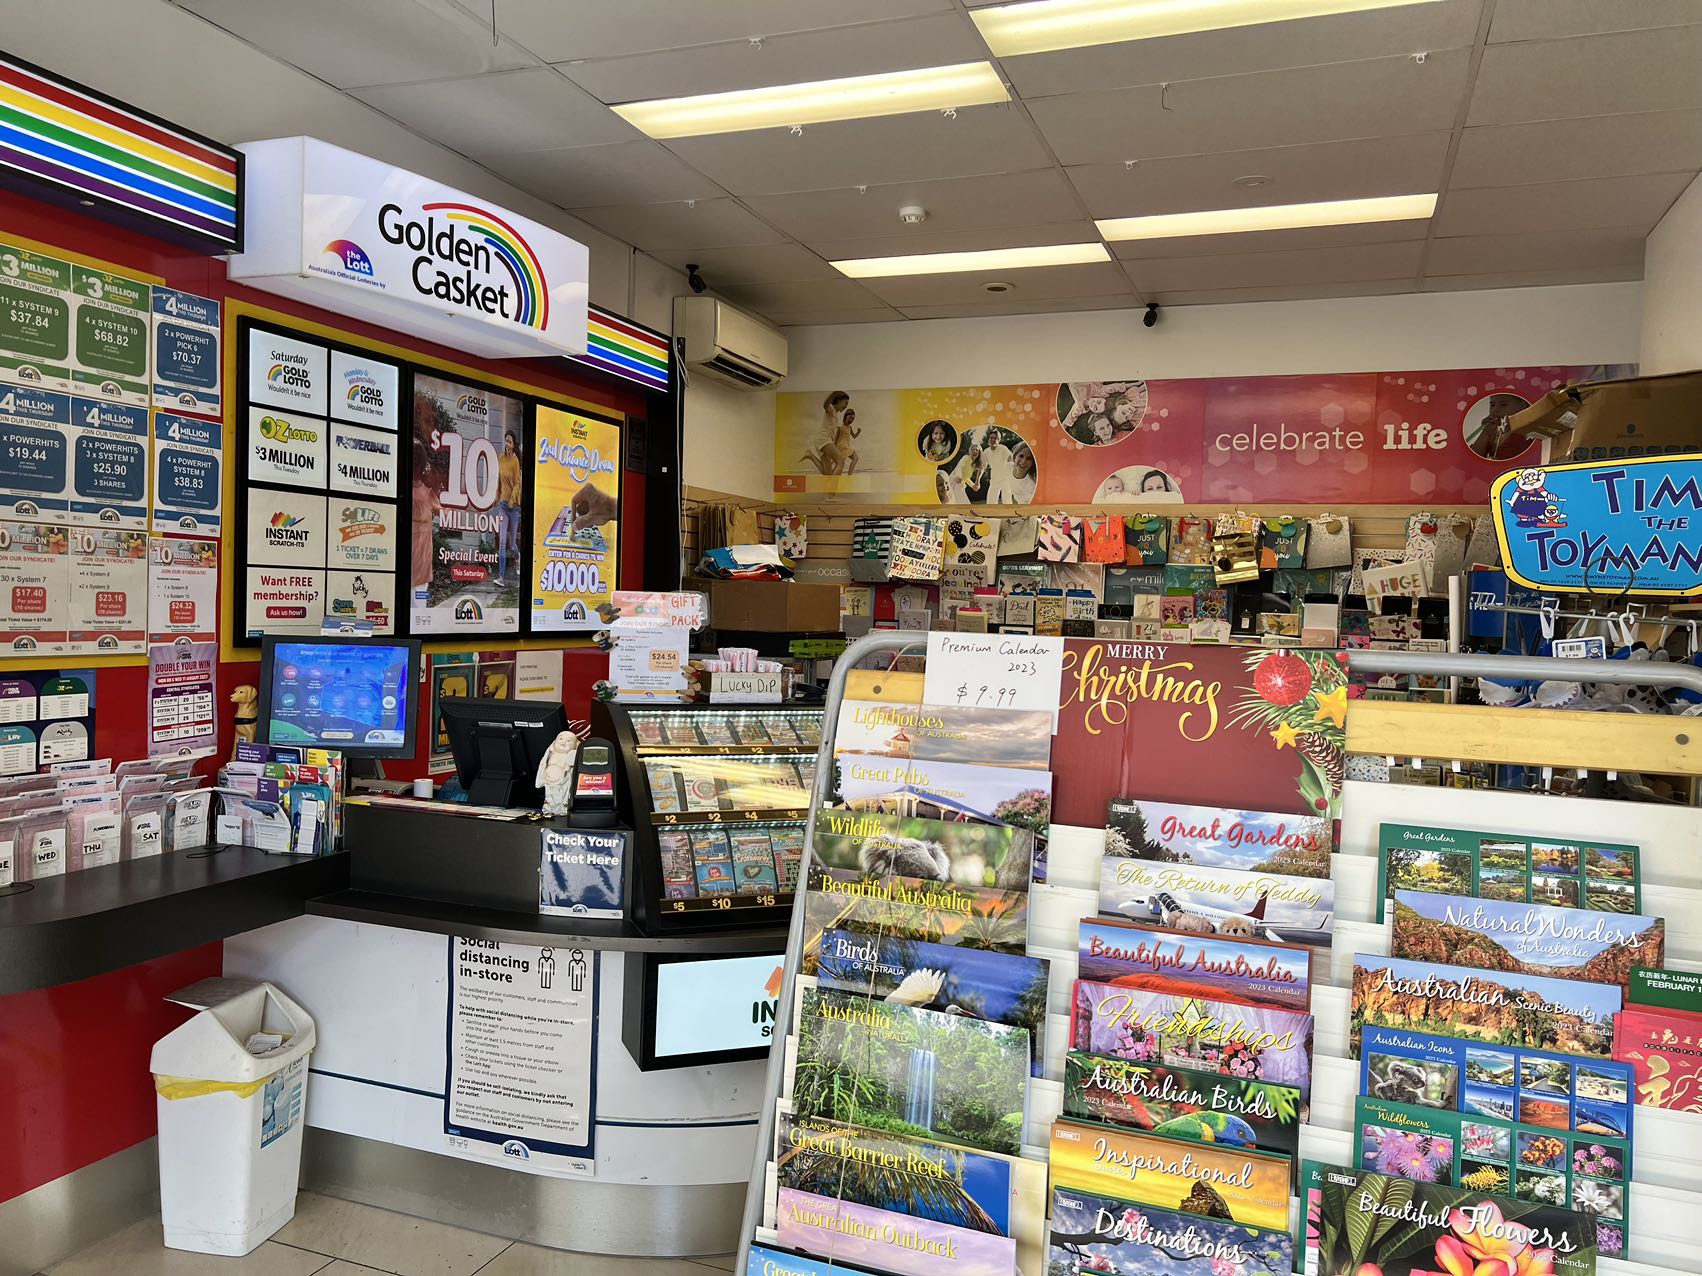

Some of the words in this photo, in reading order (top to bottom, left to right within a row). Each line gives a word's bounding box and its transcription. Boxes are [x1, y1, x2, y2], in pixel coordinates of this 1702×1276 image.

[378, 204, 491, 274] Golden
[346, 249, 361, 261] the
[346, 259, 370, 273] Lott
[308, 264, 336, 276] Australia's
[337, 271, 356, 282] Official
[357, 276, 379, 288] Lotteries
[412, 256, 509, 319] Casket
[10, 309, 49, 328] $37.84
[94, 329, 129, 347] $68.82
[172, 351, 201, 365] $70.37
[271, 350, 308, 366] Saturday
[283, 365, 308, 378] GOLD
[283, 376, 311, 389] LOTTO
[360, 386, 382, 397] GOLD
[360, 396, 384, 407] LOTTO
[260, 415, 290, 443] OZ
[288, 428, 317, 442] LOTTO
[1215, 423, 1364, 451] celebrate
[1382, 422, 1448, 450] life
[9, 434, 60, 449] POWERHITS
[8, 447, 47, 461] $19.44
[255, 446, 267, 461] $3
[268, 450, 315, 470] MILLION
[539, 438, 558, 464] 2nd
[560, 445, 591, 470] Chance
[93, 463, 127, 476] $25.90
[338, 463, 348, 477] $4
[350, 467, 389, 483] MILLION
[431, 429, 500, 511] $10
[174, 477, 204, 489] $38.83
[1591, 469, 1702, 514] TIM
[1641, 516, 1690, 531] THE
[266, 528, 310, 541] INSTANT
[1138, 534, 1155, 542] JUST
[269, 539, 305, 548] SCRATCH-ITS
[439, 547, 472, 563] Special
[474, 550, 499, 563] Event
[1526, 530, 1702, 575] TOYMAN
[261, 576, 287, 587] Want
[290, 576, 313, 587] FREE
[453, 569, 463, 577] This
[463, 570, 484, 579] Saturday
[540, 561, 599, 594] $10,000
[1380, 574, 1422, 593] HUGE
[253, 591, 319, 603] membership?
[671, 595, 696, 608] GIFT
[288, 608, 303, 616] how!
[455, 605, 474, 620] Lott
[564, 607, 579, 620] Lott
[671, 615, 699, 626] PACK
[941, 638, 992, 654] Premium
[999, 641, 1050, 656] Calendar
[1107, 643, 1168, 660] MERRY
[652, 653, 676, 661] $24.54
[156, 662, 180, 673] DOUBLE
[181, 661, 197, 671] YOUR
[198, 660, 211, 669] WIN
[1008, 662, 1037, 676] 2023
[976, 685, 1017, 708] 9.99
[854, 707, 944, 730] Lighthouses
[927, 731, 967, 740] AUSTRALIA
[851, 764, 891, 783] Great
[894, 770, 929, 786] Pubs
[665, 815, 677, 824] $2
[708, 813, 721, 822] $2
[745, 811, 758, 820] $4
[787, 811, 798, 819] $5
[829, 816, 887, 838] Wildlife
[1160, 815, 1222, 843] Great
[1227, 821, 1322, 852] Gardens
[143, 832, 159, 841] SAT
[546, 833, 585, 847] Check
[587, 836, 619, 848] Your
[1403, 831, 1424, 842] Great
[1425, 833, 1456, 844] Gardens
[83, 844, 102, 854] THU
[863, 840, 902, 850] AUSTRALIA
[38, 852, 57, 862] WED
[545, 851, 584, 864] Ticket
[587, 853, 619, 865] Here
[1273, 855, 1290, 865] 2023
[1292, 857, 1325, 868] Calendar
[1116, 861, 1154, 886] The
[1154, 869, 1232, 896] Return
[1234, 881, 1258, 899] of
[1254, 877, 1322, 909] Teddy
[756, 895, 775, 906] $15
[821, 875, 893, 902] Beautiful
[896, 885, 972, 912] Australia
[673, 901, 685, 911] $5
[712, 898, 731, 909] $10
[1438, 905, 1537, 937] Natural
[1538, 912, 1647, 948] Wonders
[460, 937, 500, 950] Social
[835, 938, 879, 962] Birds
[1517, 940, 1527, 954] of
[1527, 941, 1592, 959] Australia
[460, 950, 530, 973] distancing
[1089, 935, 1186, 971] Beautiful
[1189, 949, 1298, 985] Australia
[460, 965, 513, 983] in-store
[864, 963, 904, 976] AUSTRALIA
[1647, 980, 1696, 992] FEBRUARY
[1673, 975, 1699, 984] LUNAR
[1248, 982, 1266, 992] 2023
[1268, 985, 1300, 996] Calendar
[1371, 968, 1513, 1007] Australian
[1515, 996, 1552, 1014] Scenic
[1553, 1001, 1596, 1024] Beauty
[816, 1000, 891, 1030] Australia
[1097, 994, 1297, 1054] Friendships
[1552, 1021, 1574, 1032] 2023
[1575, 1024, 1614, 1037] Calendar
[1371, 1033, 1426, 1052] Australian
[1427, 1039, 1456, 1056] Icons
[1082, 1065, 1209, 1107] Australian
[1211, 1084, 1278, 1120] Birds
[1363, 1104, 1388, 1113] Australian
[492, 1121, 524, 1130] health.gov.au
[1377, 1112, 1430, 1129] Wildflowers
[799, 1120, 829, 1133] ISLANDS
[830, 1127, 842, 1136] OF
[843, 1129, 858, 1139] THE
[790, 1128, 836, 1156] Great
[841, 1140, 903, 1170] Barrier
[907, 1152, 946, 1179] Reef
[1093, 1137, 1254, 1189] Inspirational
[1358, 1192, 1452, 1231] Beautiful
[1460, 1206, 1577, 1254] Flowers
[787, 1204, 876, 1241] Australian
[881, 1225, 958, 1260] Outback
[1095, 1207, 1248, 1263] Destinations
